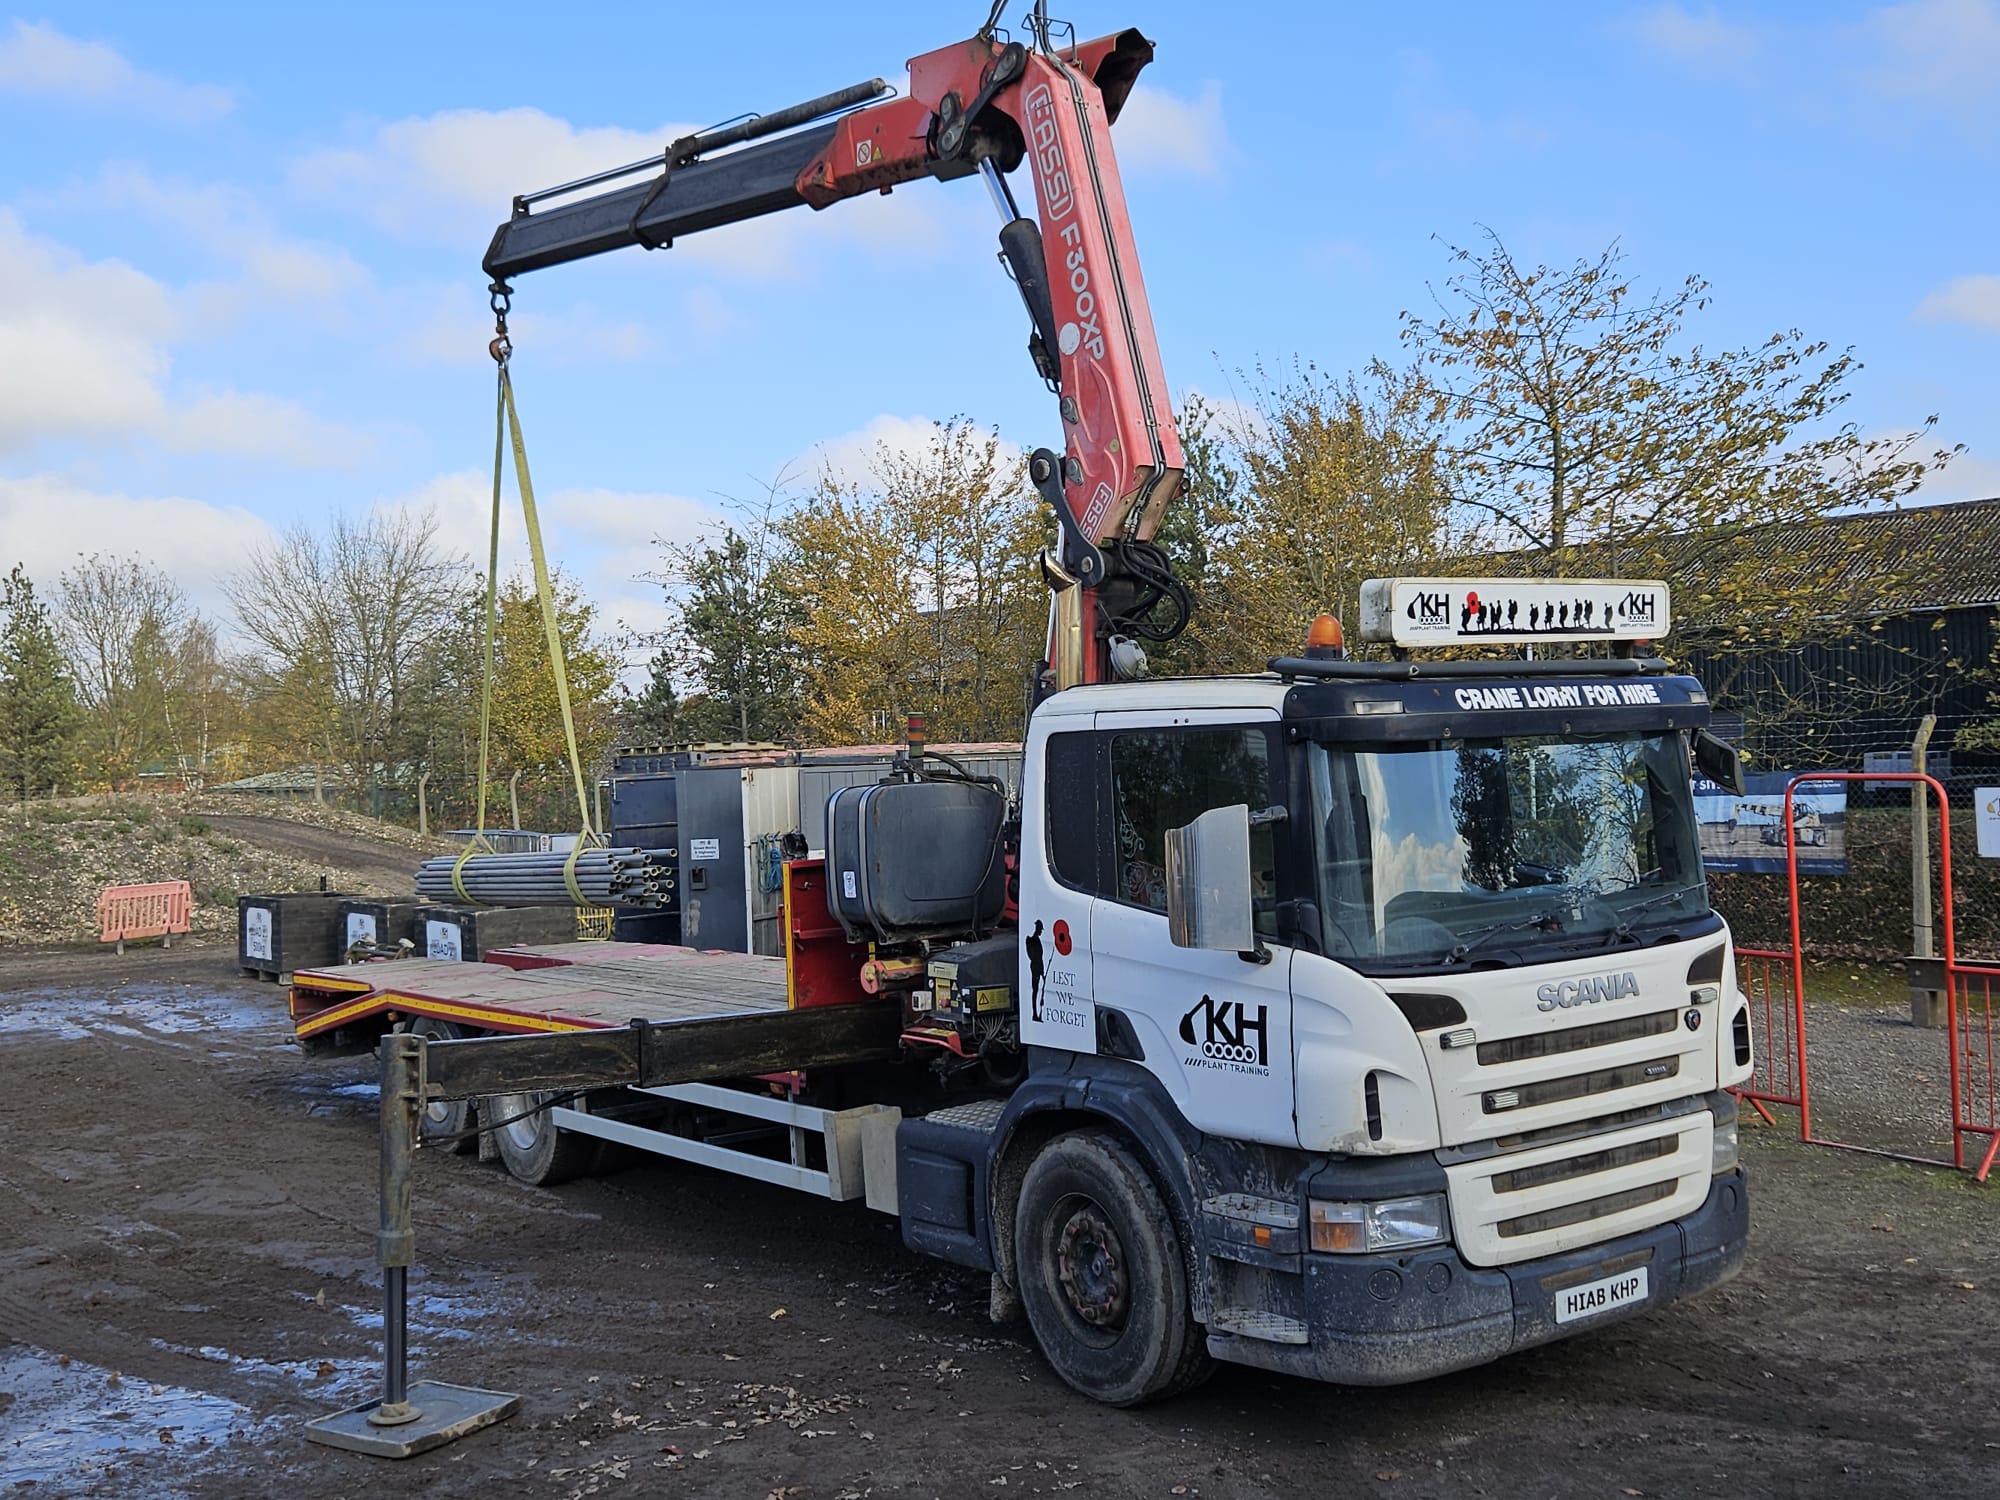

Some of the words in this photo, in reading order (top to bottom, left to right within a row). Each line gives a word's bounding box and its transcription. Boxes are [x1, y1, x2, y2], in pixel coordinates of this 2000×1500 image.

[1029, 93, 1070, 211] FASSI
[1060, 221, 1105, 360] F300XP
[1082, 489, 1109, 539] FASS
[1419, 592, 1450, 625] KH
[1629, 592, 1654, 622] KH
[1454, 687, 1523, 710] CRANE
[1521, 685, 1582, 708] LORRY
[1582, 685, 1622, 706] FOR
[1617, 684, 1661, 704] HIRE
[1053, 970, 1076, 987] LEST
[1537, 971, 1641, 1012] SCANIA
[1055, 990, 1075, 1006] WE
[1046, 1007, 1087, 1028] FORGET
[1203, 998, 1268, 1067] KH
[1202, 1060, 1228, 1071] PLANT
[1229, 1063, 1270, 1077] TRAINING
[1567, 1287, 1606, 1315] HIAB
[1610, 1277, 1639, 1302] KHP
